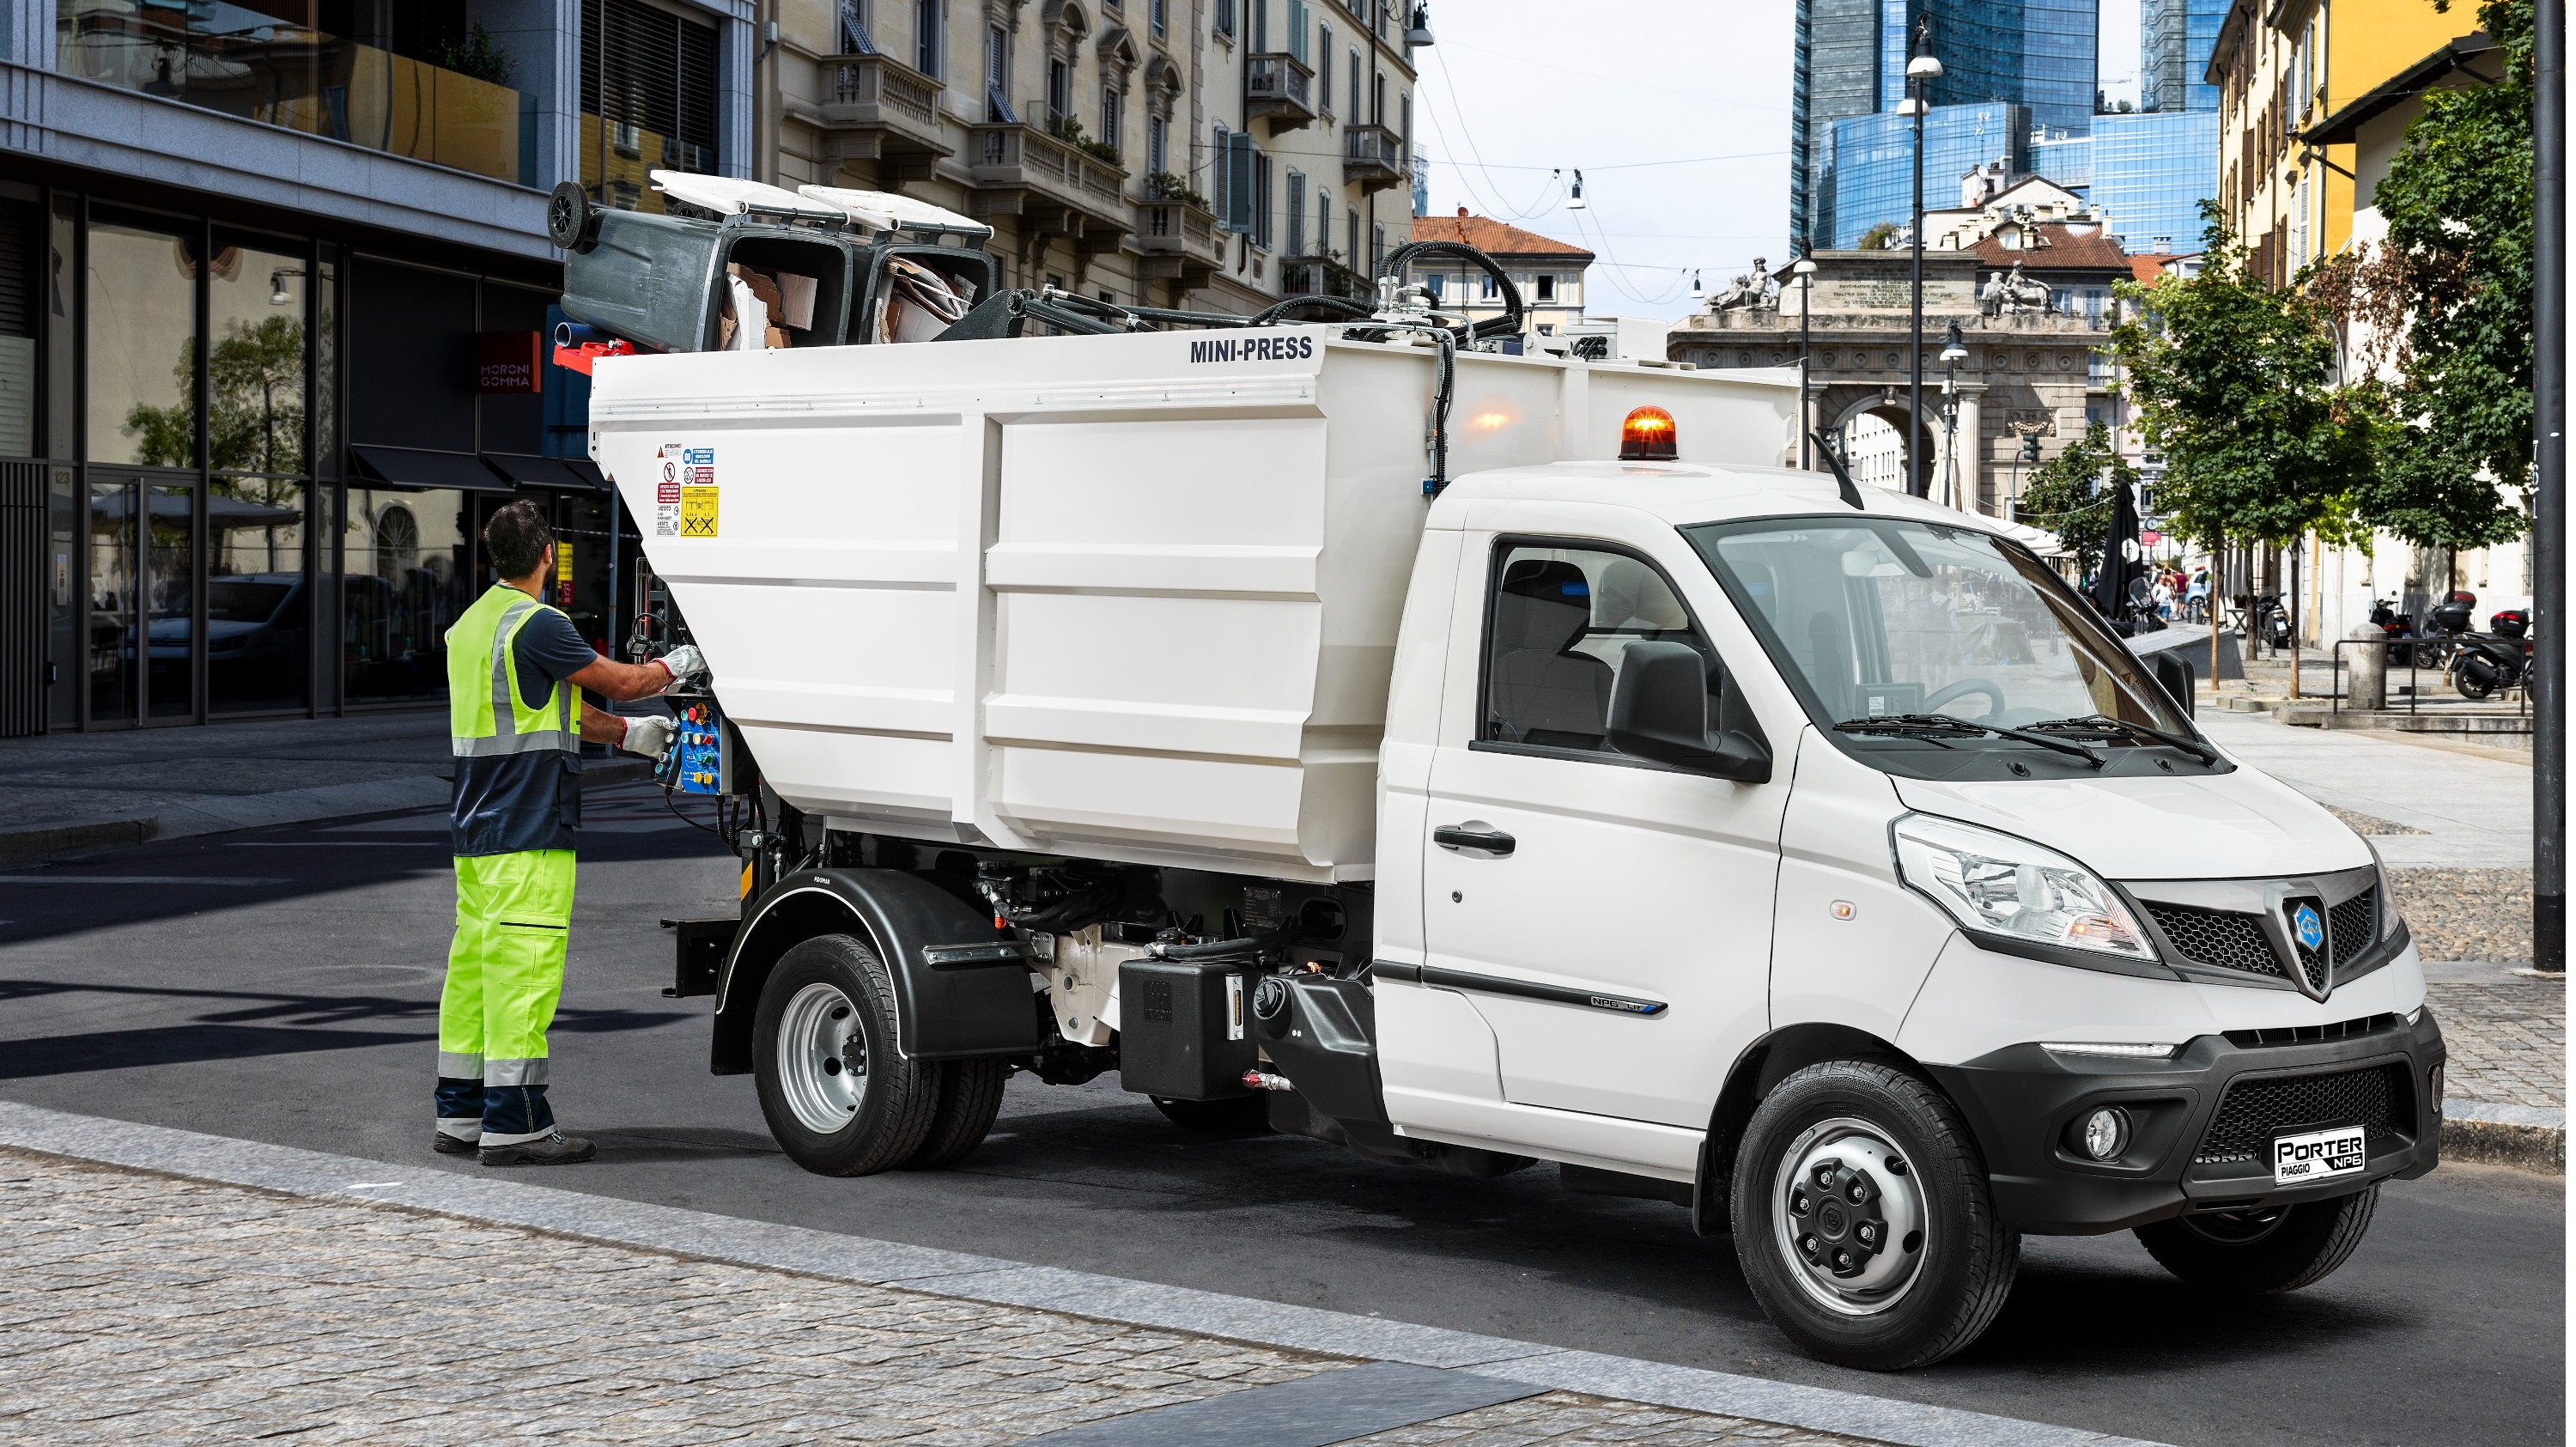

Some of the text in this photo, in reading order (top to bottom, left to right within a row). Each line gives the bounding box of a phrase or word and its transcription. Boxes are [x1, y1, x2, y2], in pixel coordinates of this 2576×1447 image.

[1190, 336, 1312, 363] MINI-PRESS
[481, 364, 529, 374] MORONI
[481, 376, 530, 386] GOMMA
[54, 471, 70, 484] 123
[1593, 998, 1619, 1007] NP6
[2334, 1155, 2361, 1168] NP6
[2281, 1164, 2310, 1176] PIAGGIO
